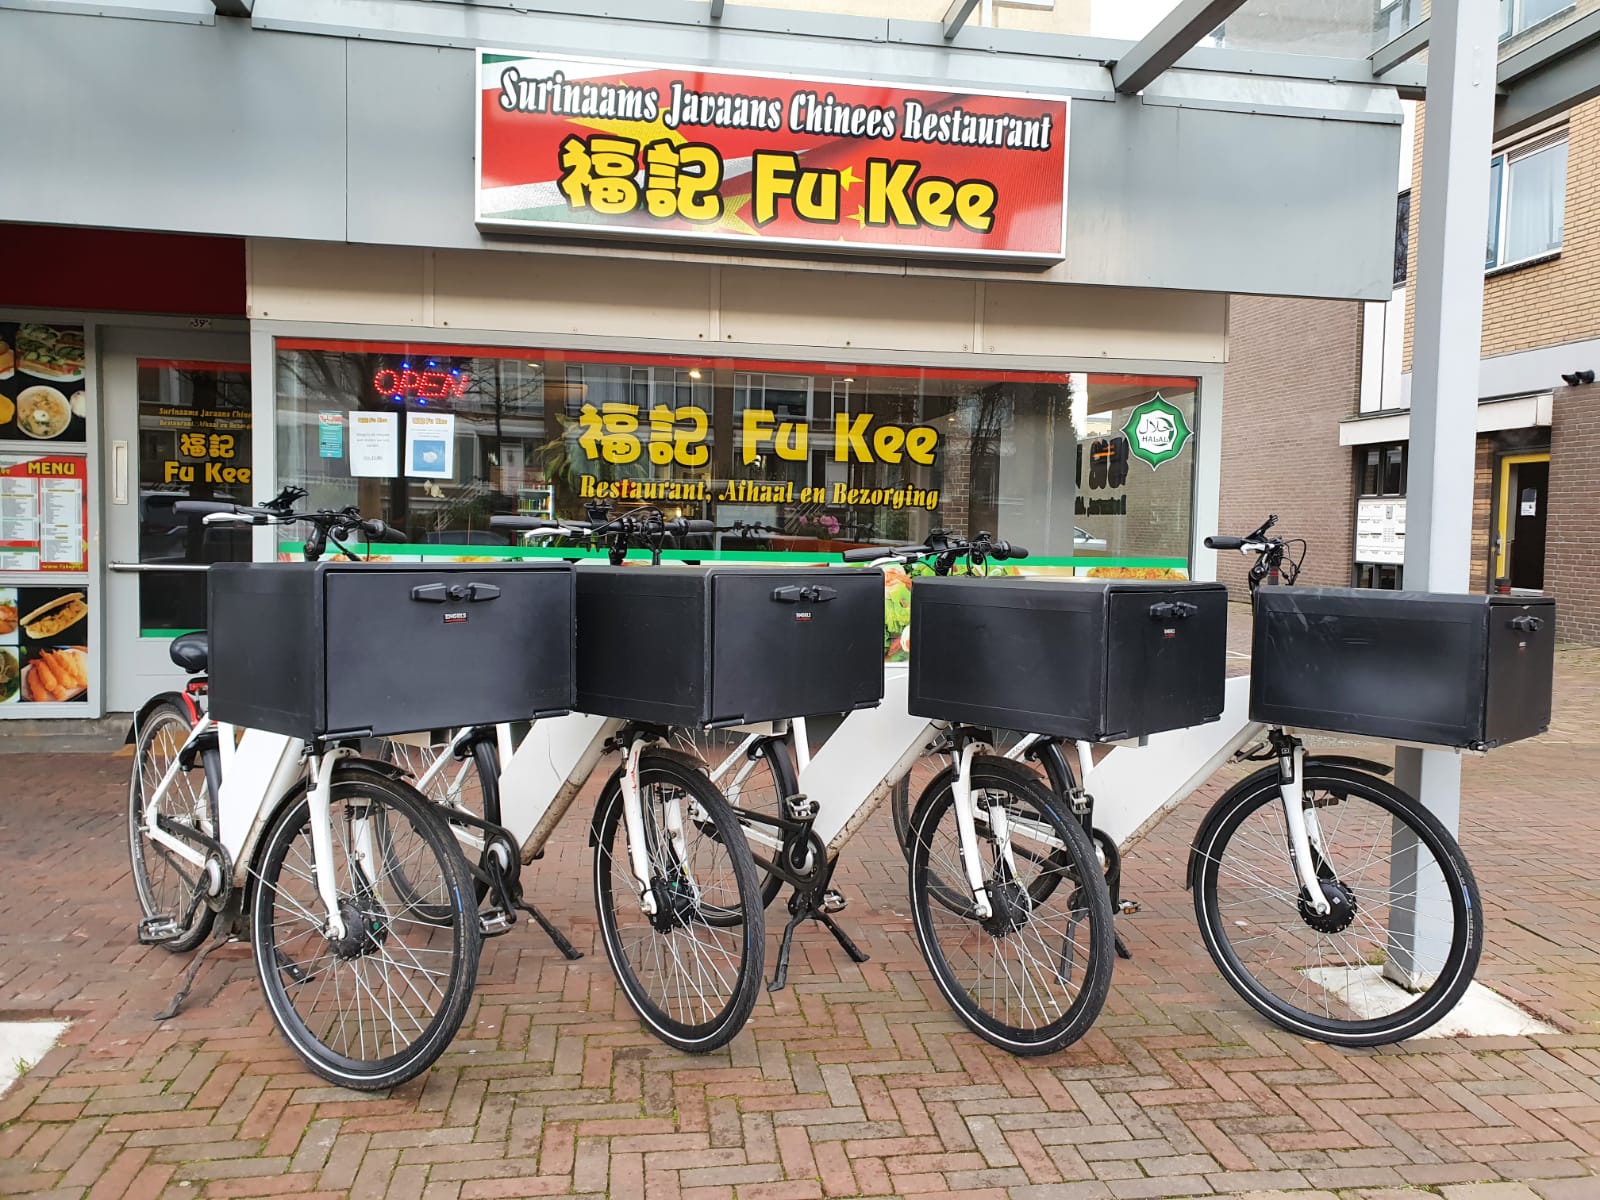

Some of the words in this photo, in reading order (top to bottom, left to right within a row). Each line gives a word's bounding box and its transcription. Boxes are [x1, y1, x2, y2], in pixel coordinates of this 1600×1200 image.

[499, 69, 660, 122] Surinaams
[664, 82, 783, 130] Javaans
[788, 91, 897, 139] Chinees
[901, 100, 1052, 150] Restaurant
[559, 136, 721, 222] 福記
[754, 152, 839, 225] Fu
[867, 160, 996, 231] Kee
[373, 368, 469, 399] OPEN
[180, 432, 235, 458] 福記
[578, 402, 709, 466] 福記
[741, 408, 809, 467] Fu
[834, 412, 939, 465] Kee
[1138, 418, 1171, 435] حلال
[27, 461, 75, 475] MENU
[164, 460, 195, 484] Fu
[204, 462, 251, 484] Kee
[578, 474, 713, 503] Restaurant,
[718, 479, 795, 503] Afhaal
[799, 486, 827, 505] en
[831, 481, 939, 511] Bezorging
